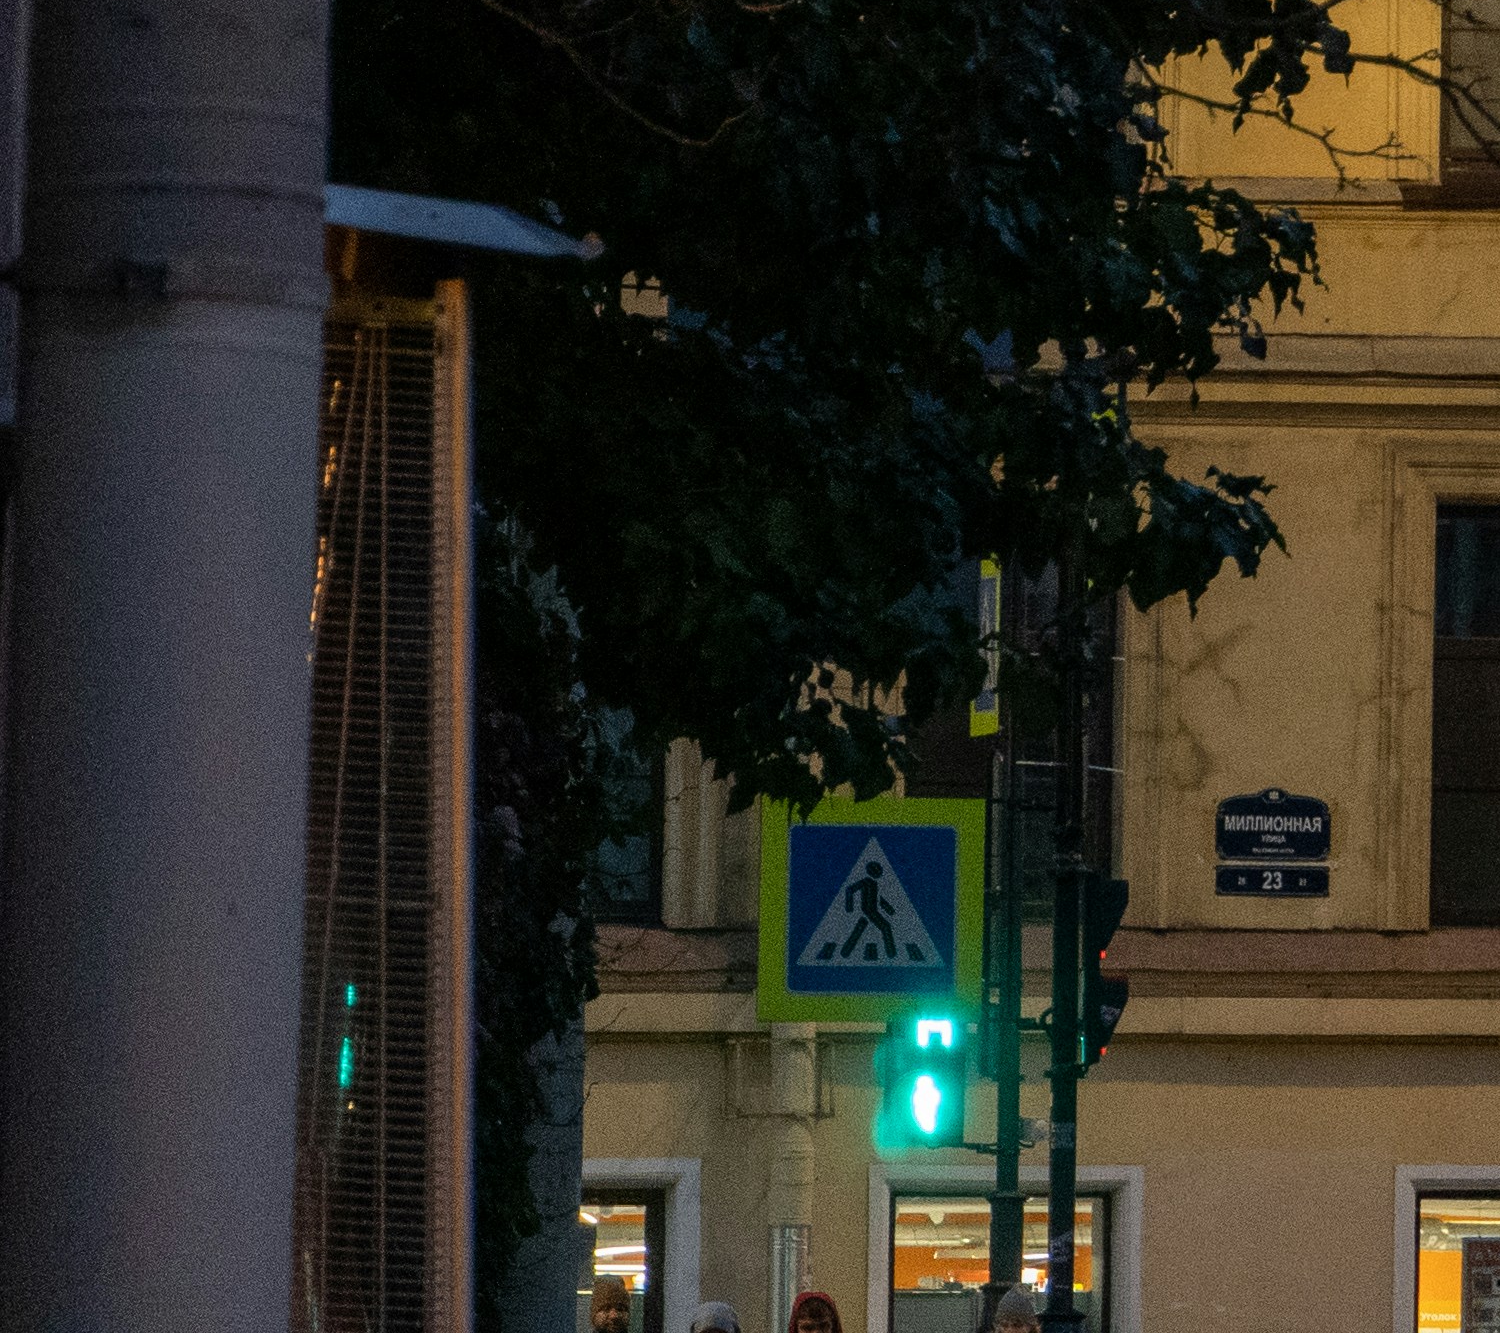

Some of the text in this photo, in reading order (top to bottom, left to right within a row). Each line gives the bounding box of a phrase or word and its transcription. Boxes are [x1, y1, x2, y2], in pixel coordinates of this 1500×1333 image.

[1224, 814, 1322, 833] МИЛЛИОННАЯ
[1261, 870, 1283, 890] 23
[1419, 1312, 1458, 1322] Уголок
